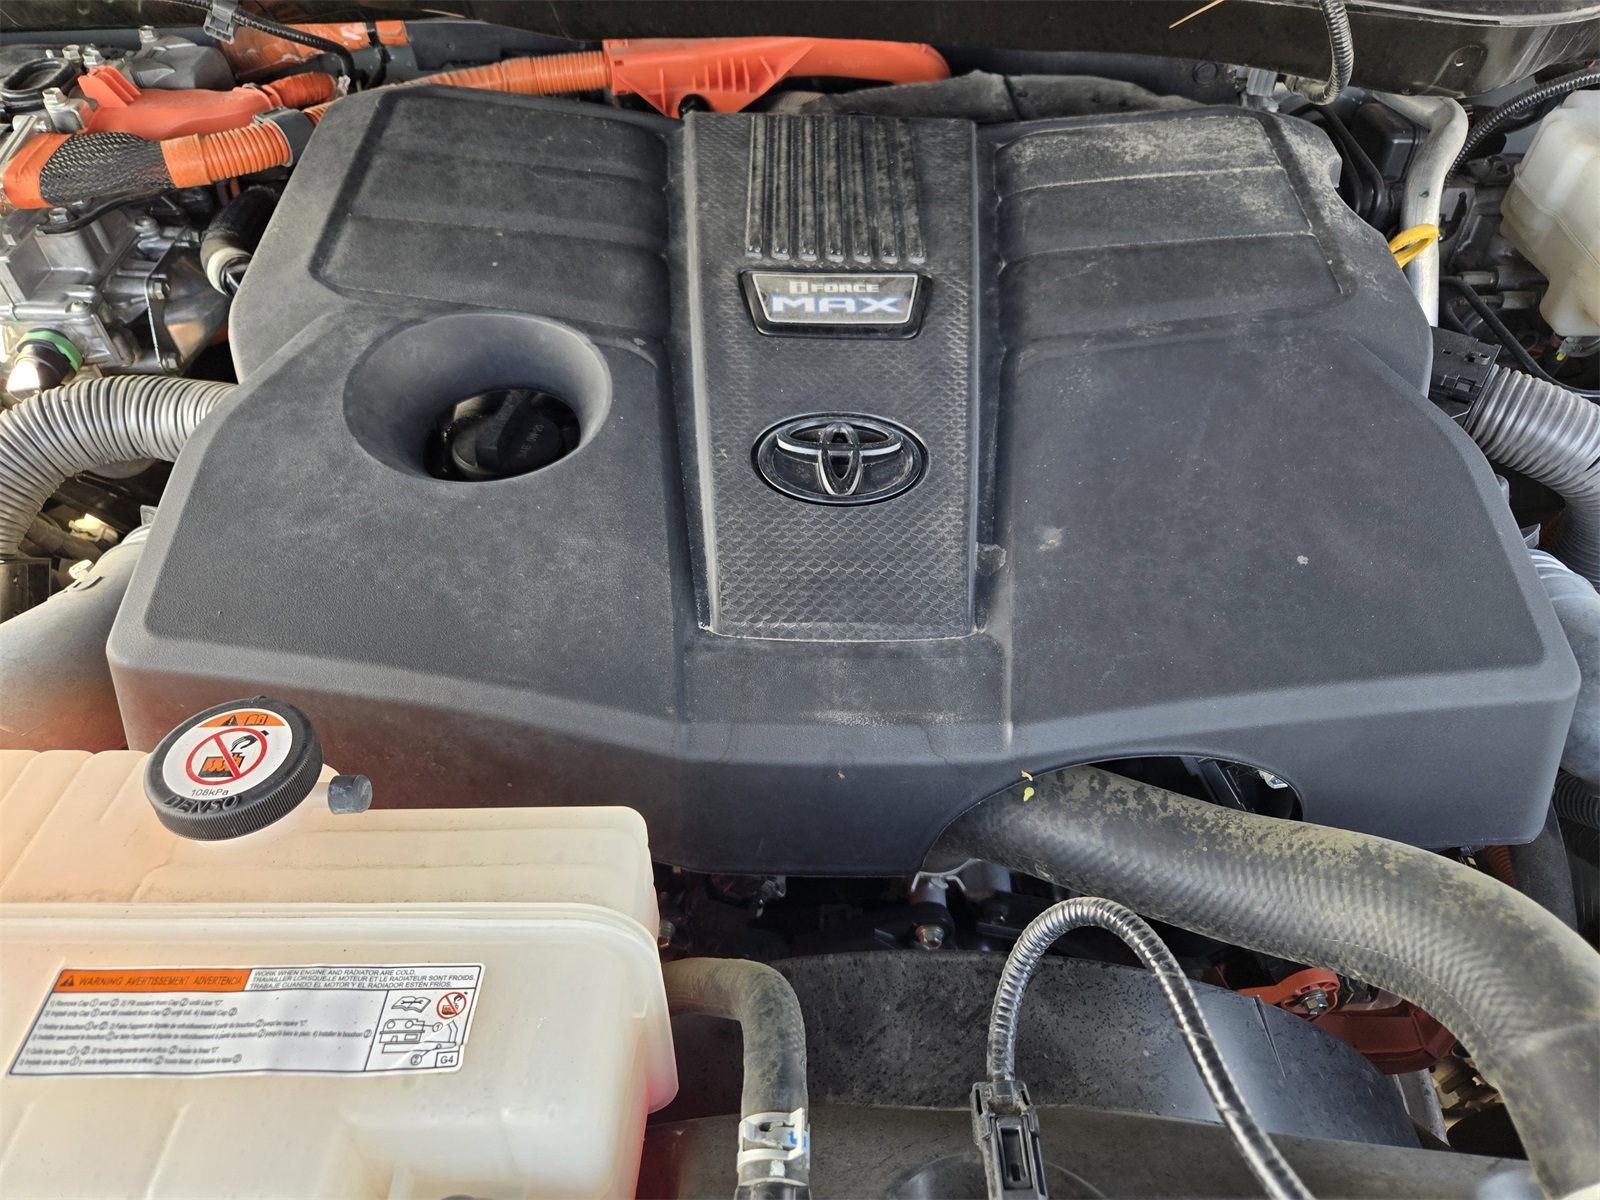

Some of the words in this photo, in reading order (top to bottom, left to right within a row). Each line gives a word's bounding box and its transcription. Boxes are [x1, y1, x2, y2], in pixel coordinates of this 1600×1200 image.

[771, 295, 903, 314] MAX
[191, 788, 229, 797] 108kPa
[163, 794, 241, 814] DENSO
[79, 976, 123, 986] WARNING
[126, 975, 190, 986] AVERTISSEMENT
[193, 975, 242, 985] ADVERTENCIA
[440, 1055, 454, 1065] G4
